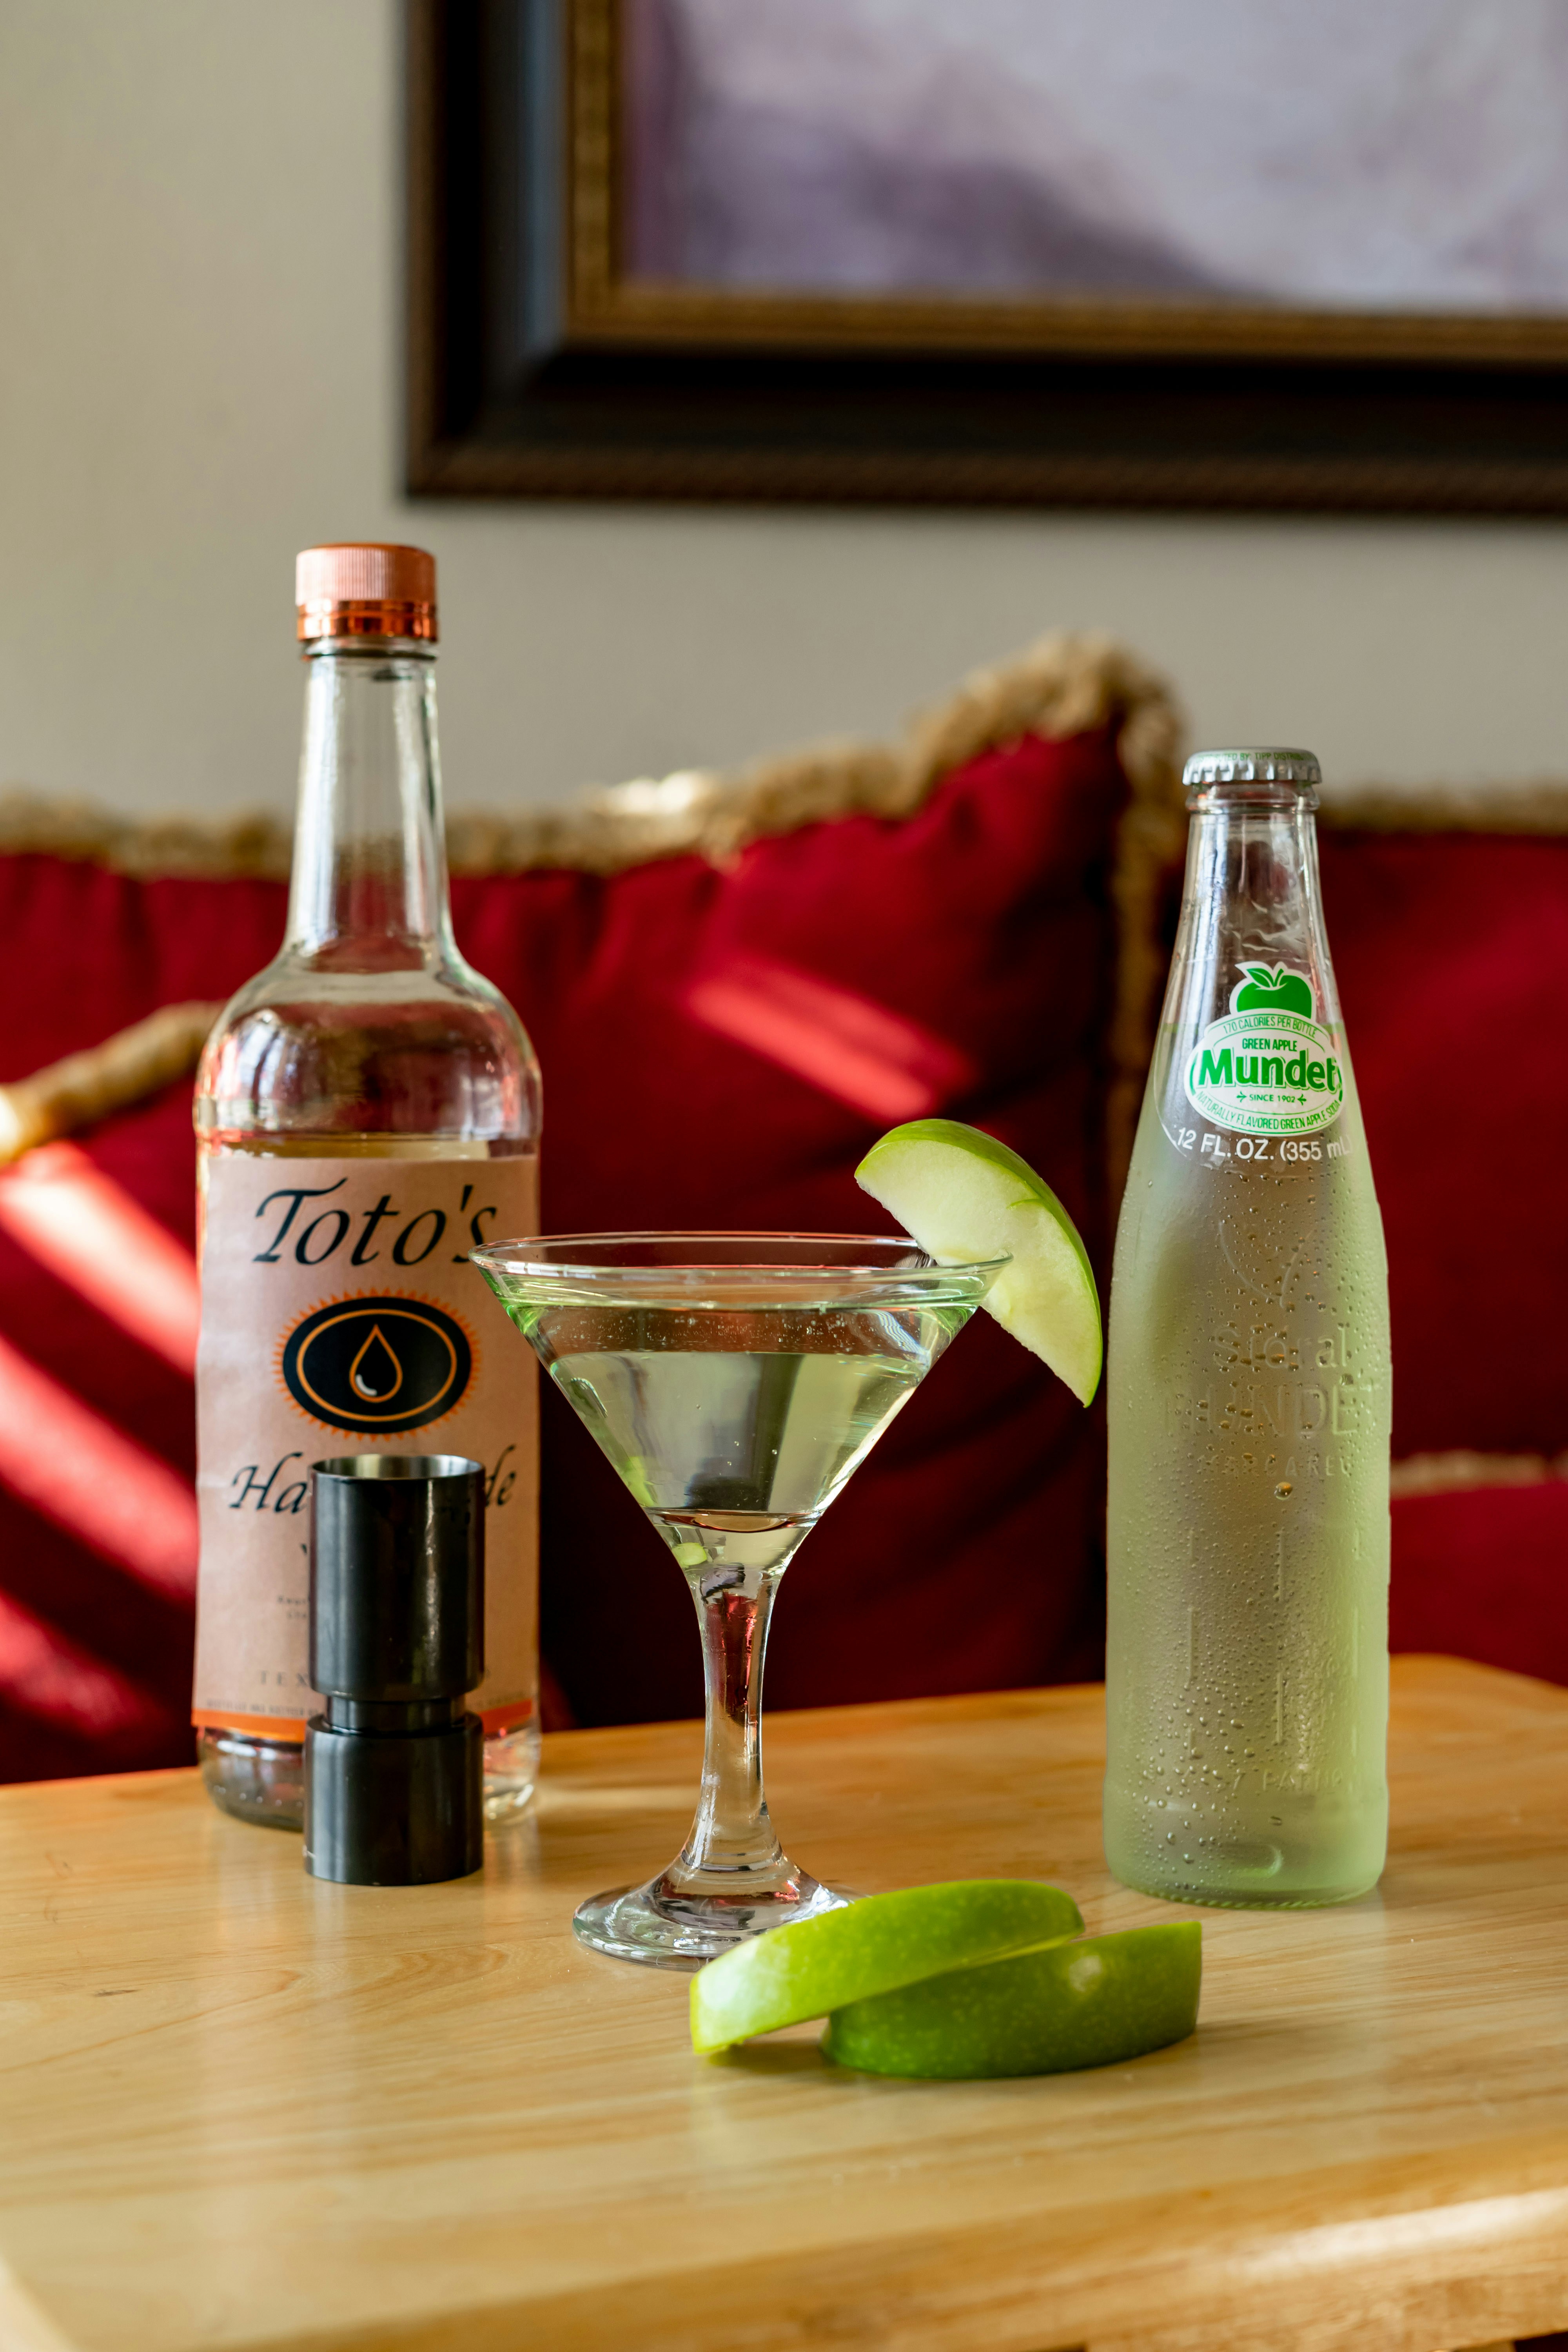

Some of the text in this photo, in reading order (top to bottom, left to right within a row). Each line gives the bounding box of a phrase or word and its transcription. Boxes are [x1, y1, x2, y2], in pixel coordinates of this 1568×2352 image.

[1224, 1016, 1318, 1038] 170 CALORIES PER BOTTLE
[1242, 1038, 1298, 1052] GREEN APPLE
[1198, 1048, 1336, 1091] Mundet
[1196, 1091, 1340, 1130] NATURALLY FLAVORED GREEN APPLE SODA
[1277, 1094, 1296, 1103] 1902
[1177, 1127, 1197, 1150] 12
[1236, 1138, 1274, 1160] OZ.
[1280, 1140, 1322, 1161] (355
[252, 1177, 497, 1267] Toto's
